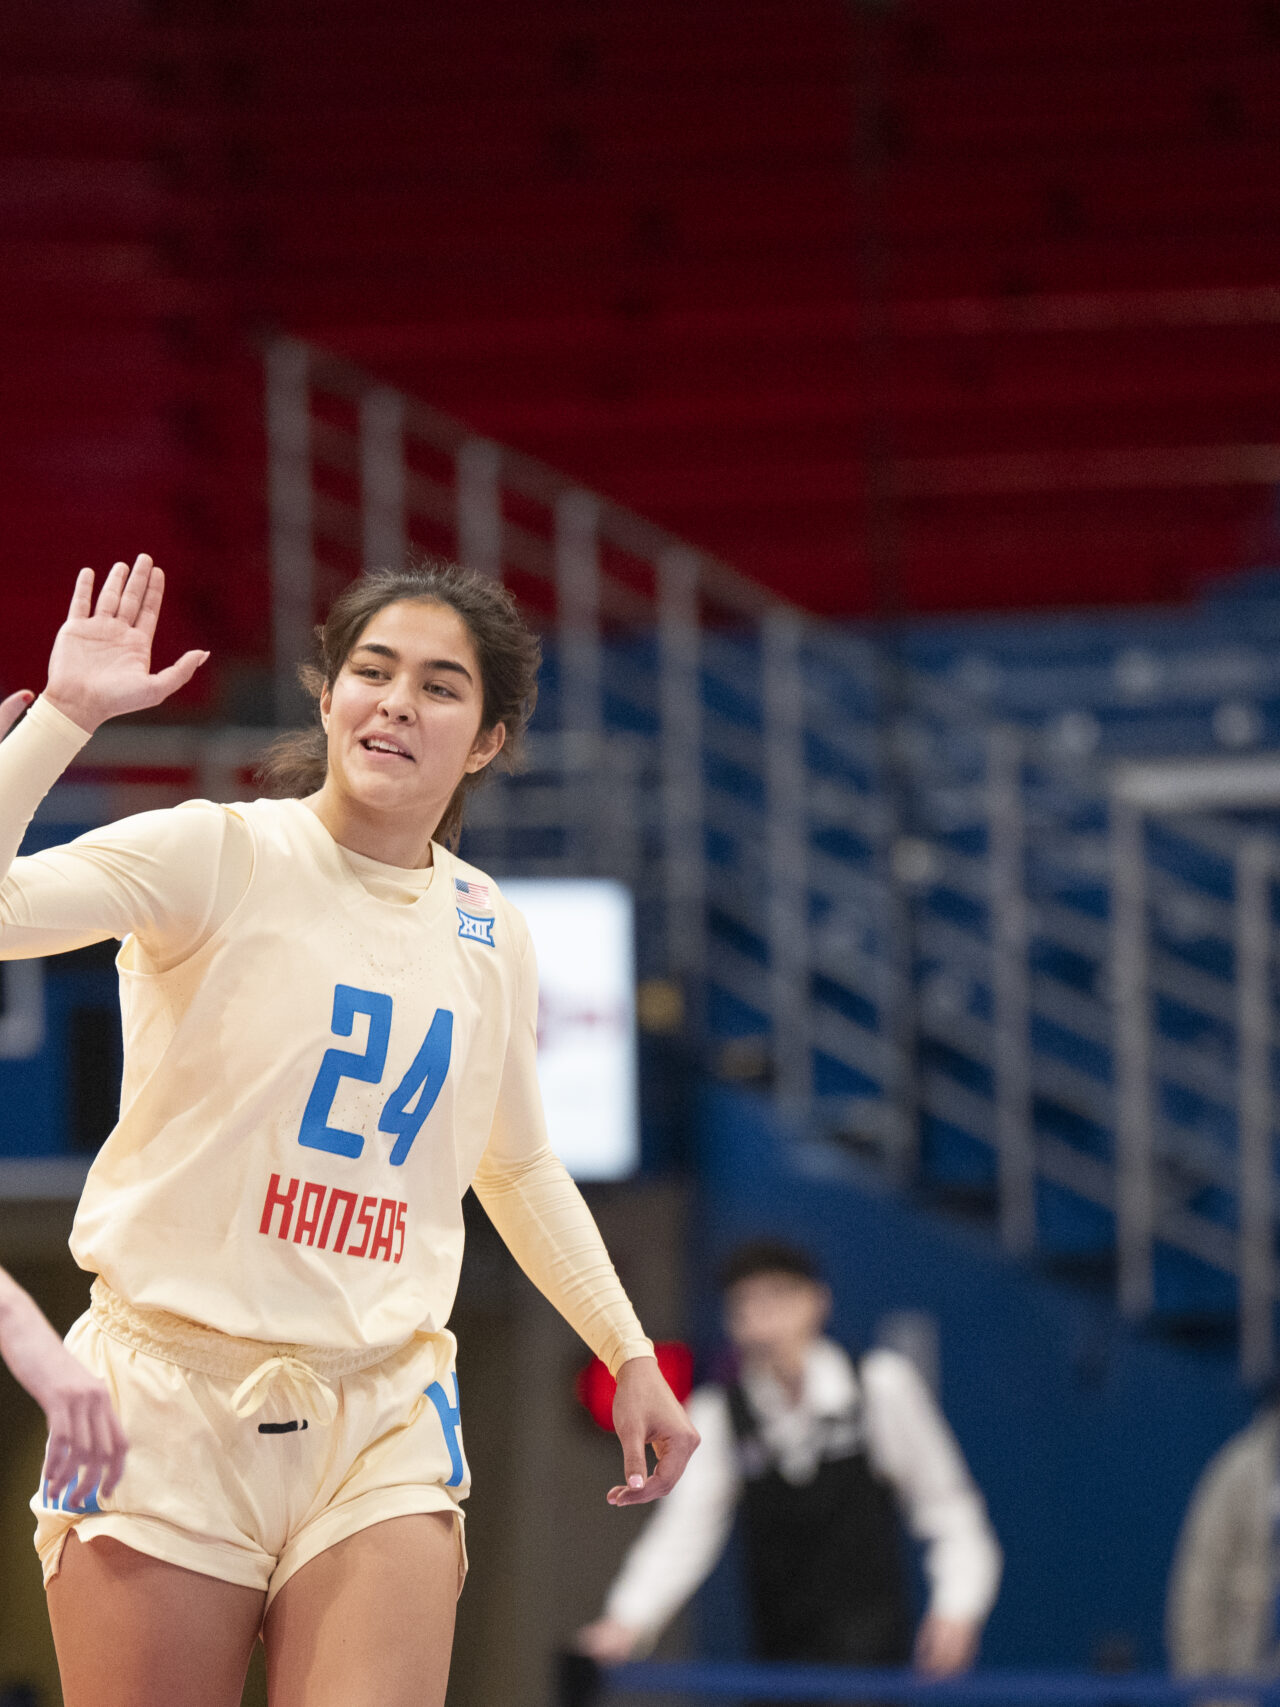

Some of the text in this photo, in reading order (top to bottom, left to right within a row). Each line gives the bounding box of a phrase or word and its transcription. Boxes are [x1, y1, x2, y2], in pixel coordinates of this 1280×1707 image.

[458, 909, 494, 946] XII
[298, 984, 453, 1166] 24
[258, 1173, 408, 1264] KANSAS
